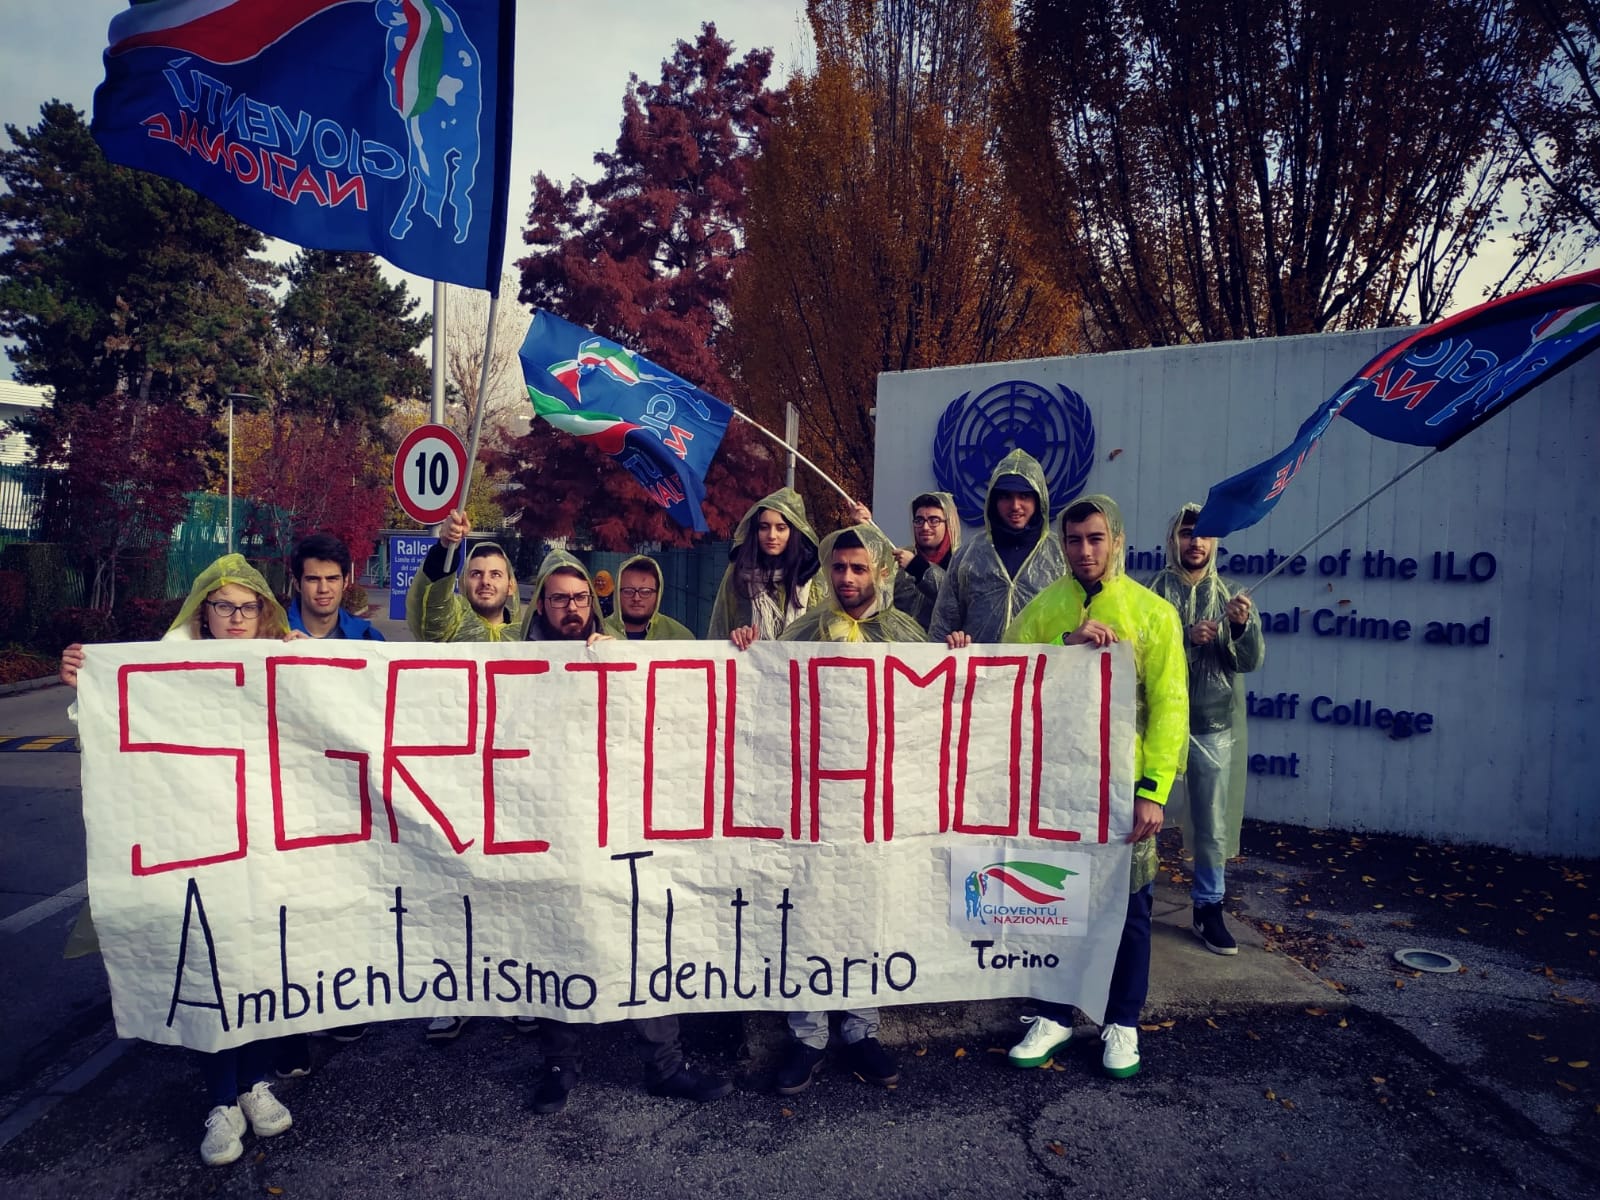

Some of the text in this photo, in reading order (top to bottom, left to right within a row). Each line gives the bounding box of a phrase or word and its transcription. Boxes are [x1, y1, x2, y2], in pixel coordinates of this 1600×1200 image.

[415, 451, 449, 496] 10
[396, 572, 414, 587] Slo
[1216, 547, 1307, 575] Centre
[1319, 548, 1351, 577] of
[1363, 549, 1418, 580] the
[1432, 550, 1497, 582] ILO
[1260, 606, 1491, 646] nal Crime and
[1246, 689, 1434, 740] taff College
[118, 652, 1112, 876] SGRETOLIAMOLI
[1246, 751, 1300, 778] ent
[993, 915, 1069, 926] NAZIONALE
[166, 850, 918, 1032] Ambientalismo Identitario
[970, 940, 1060, 970] Torino
